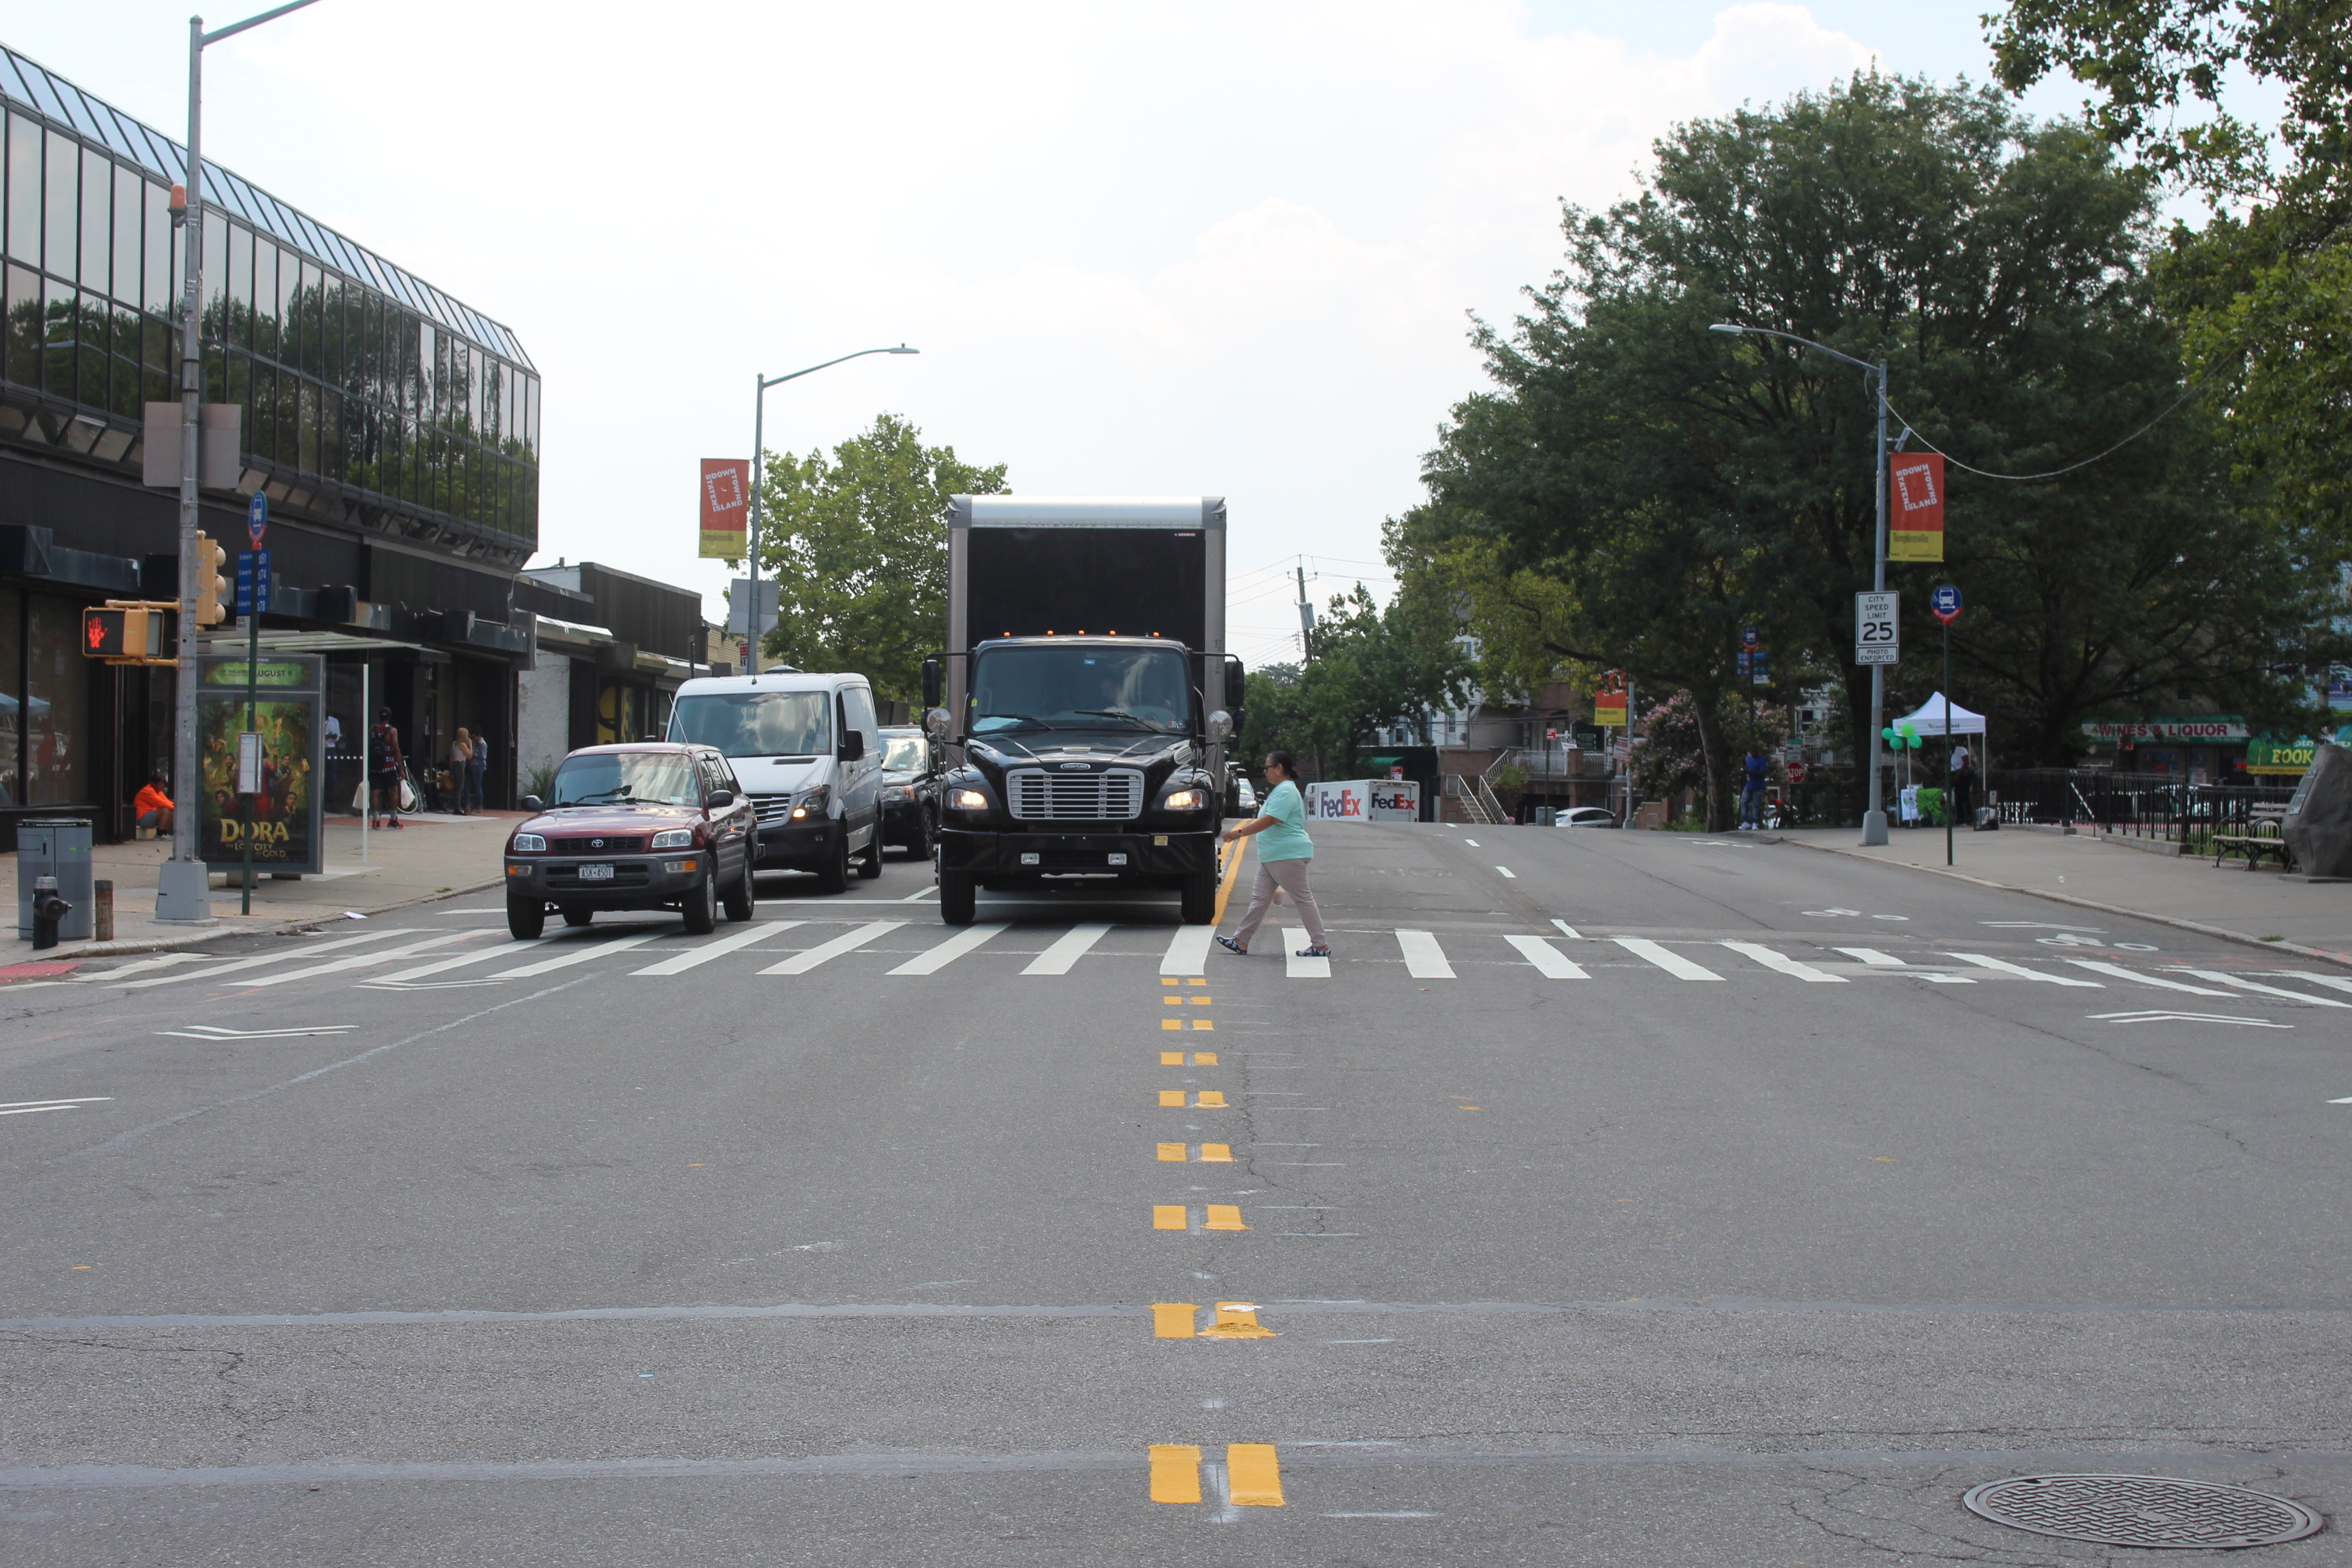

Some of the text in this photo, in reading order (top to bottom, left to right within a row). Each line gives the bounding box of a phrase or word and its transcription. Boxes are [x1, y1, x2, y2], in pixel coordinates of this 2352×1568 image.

[711, 468, 736, 479] DOWN
[1902, 463, 1929, 476] DOWN
[705, 474, 718, 506] STATEN
[732, 474, 742, 500] TOWN
[1896, 470, 1910, 505] STATEN
[1924, 470, 1936, 498] TOWN
[713, 500, 743, 512] ISLAND
[1905, 497, 1938, 511] ISLAND
[1863, 621, 1893, 641] 25
[1320, 789, 1361, 817] FedEx
[1371, 792, 1416, 810] FedEx
[220, 818, 290, 843] DORA
[235, 843, 255, 851] LOT
